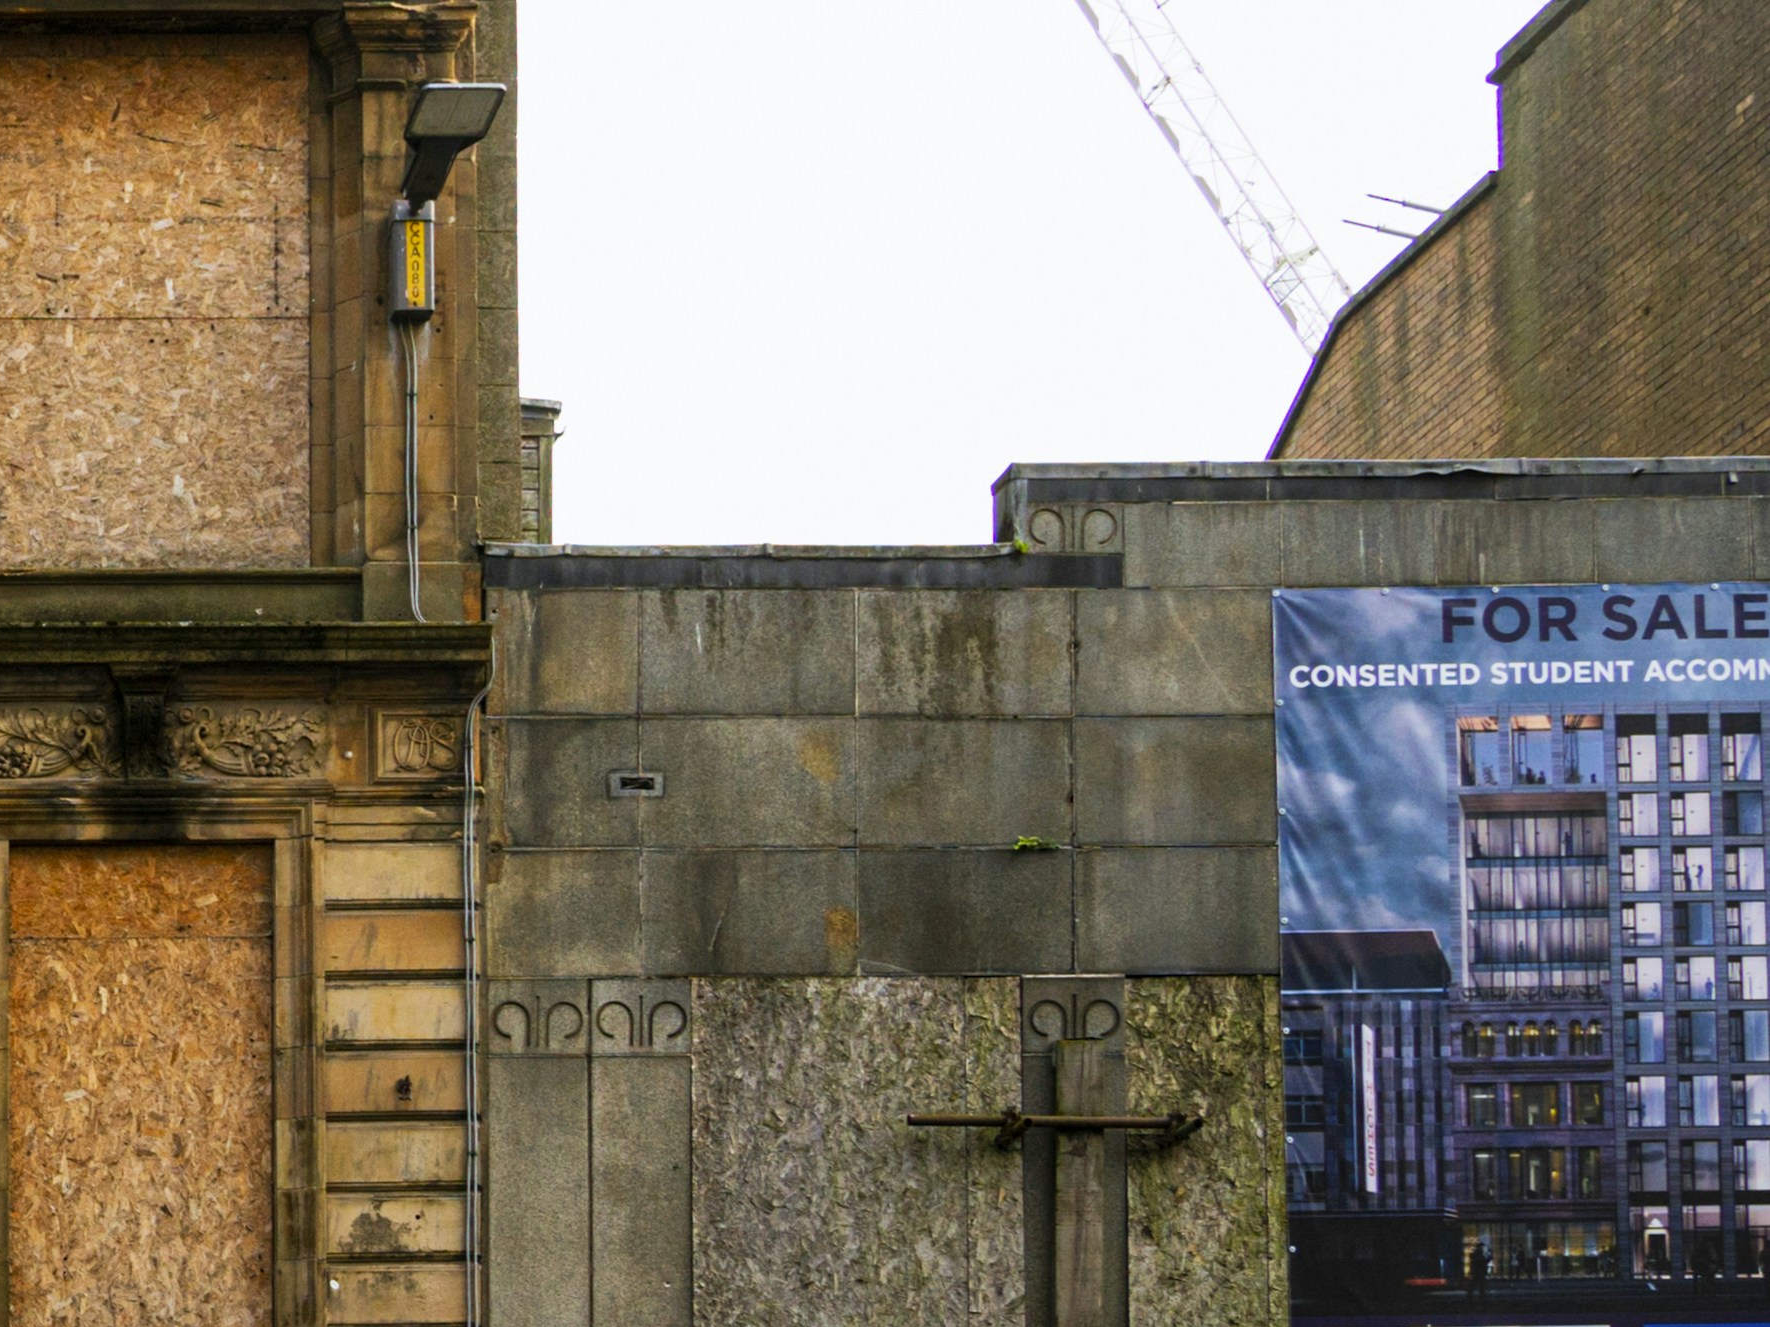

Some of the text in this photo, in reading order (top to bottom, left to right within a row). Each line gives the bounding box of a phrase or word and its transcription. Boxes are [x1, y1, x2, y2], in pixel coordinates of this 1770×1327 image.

[1441, 593, 1770, 644] FOR SALE
[1288, 662, 1481, 689] CONSENTED
[1490, 659, 1635, 685] STUDENT
